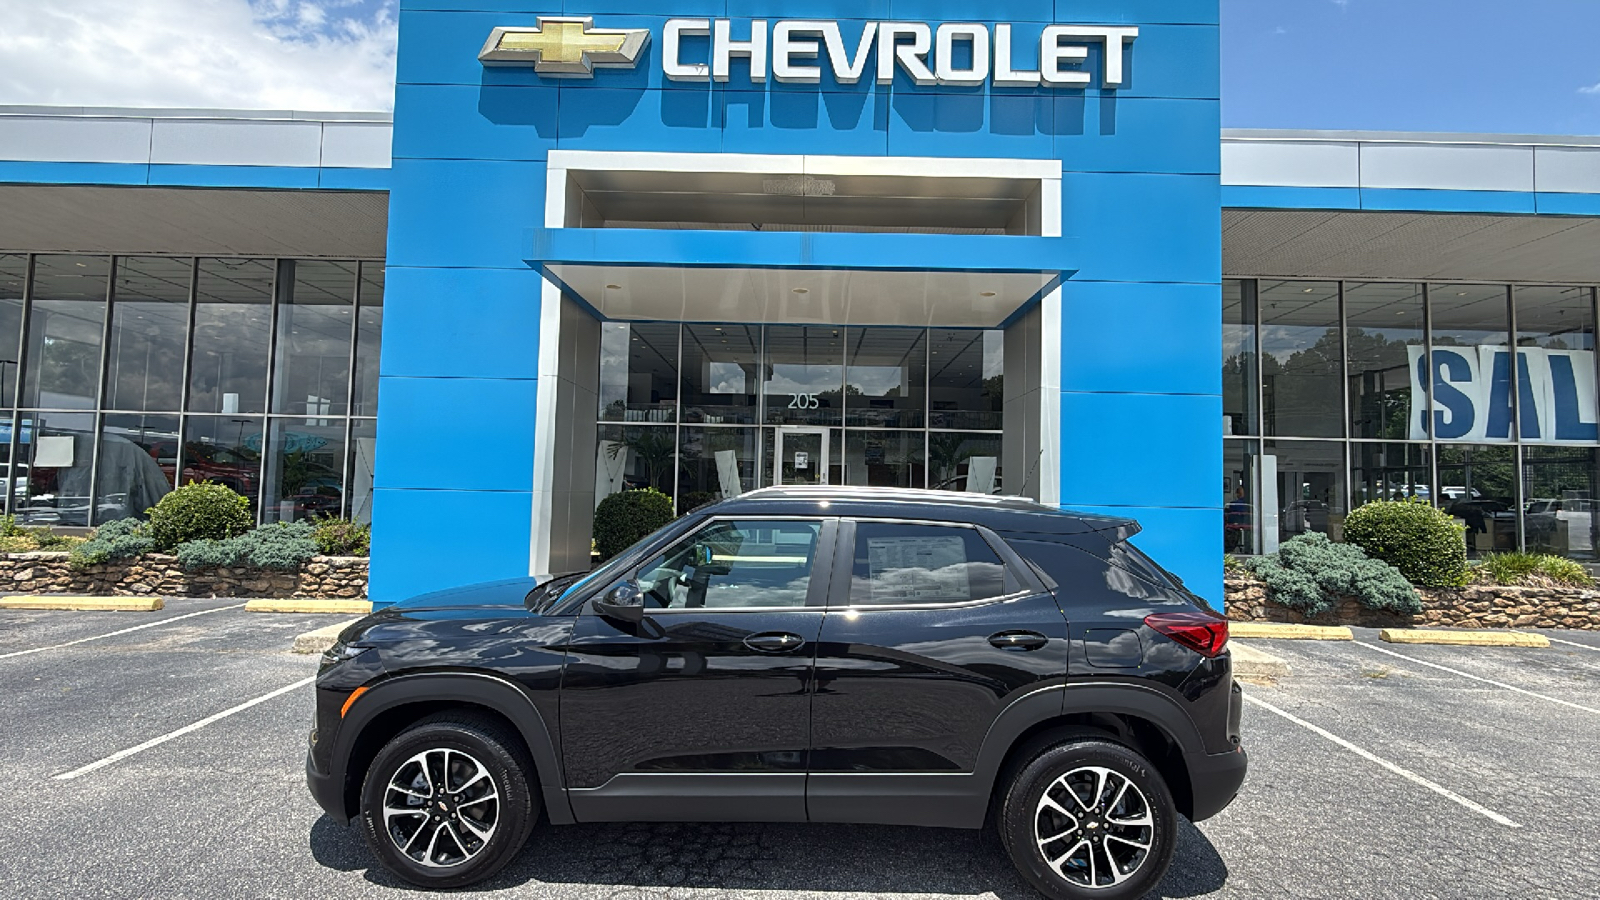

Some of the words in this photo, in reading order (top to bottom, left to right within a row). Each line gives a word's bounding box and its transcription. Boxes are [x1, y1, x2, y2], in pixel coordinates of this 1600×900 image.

[662, 19, 1139, 88] CHEVROLET
[788, 393, 818, 409] 205
[490, 757, 513, 801] ntinental
